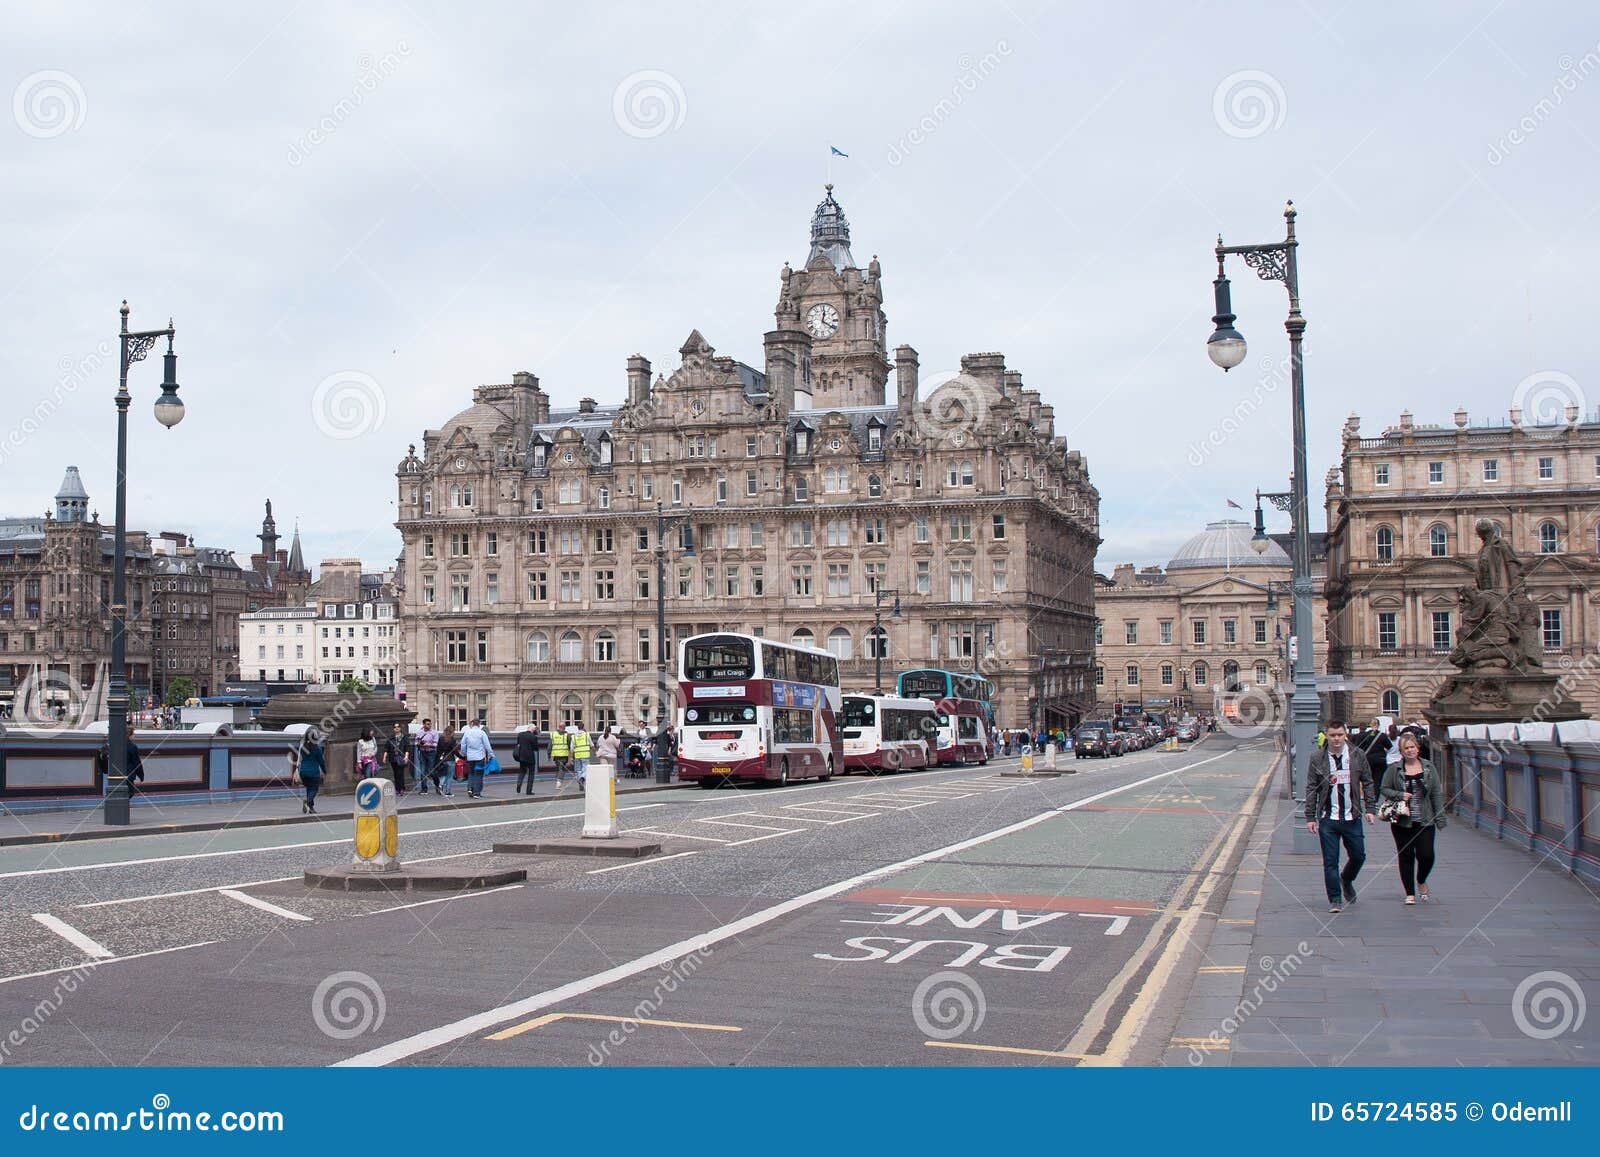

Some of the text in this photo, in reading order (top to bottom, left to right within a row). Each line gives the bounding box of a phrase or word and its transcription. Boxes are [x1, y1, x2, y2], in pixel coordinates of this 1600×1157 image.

[727, 669, 745, 677] Craigs
[840, 904, 1132, 936] LANE
[813, 936, 1072, 972] BUS
